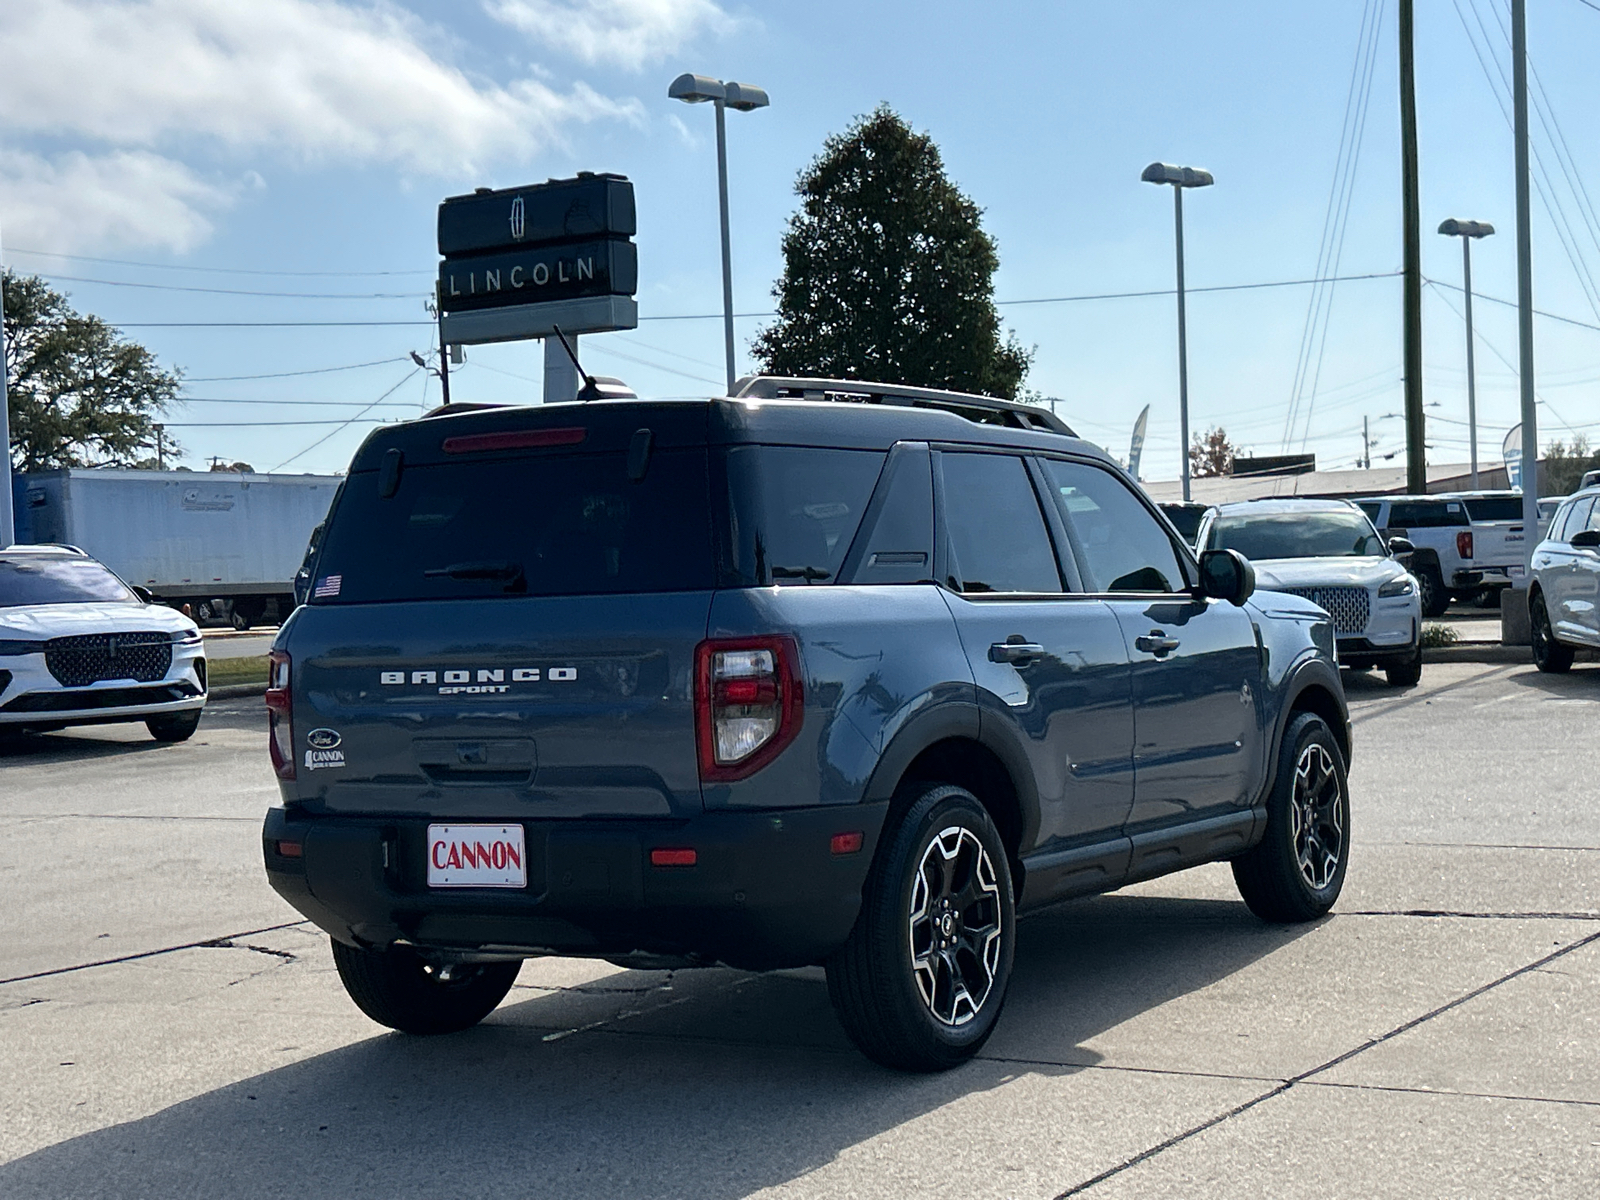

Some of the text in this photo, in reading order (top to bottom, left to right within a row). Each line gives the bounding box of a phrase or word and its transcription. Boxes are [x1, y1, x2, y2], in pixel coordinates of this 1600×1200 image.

[450, 256, 594, 296] LINCOLN
[380, 667, 577, 685] BRONCO
[438, 685, 510, 695] SPORT
[312, 750, 345, 762] CANNON
[432, 840, 521, 870] CANNON
